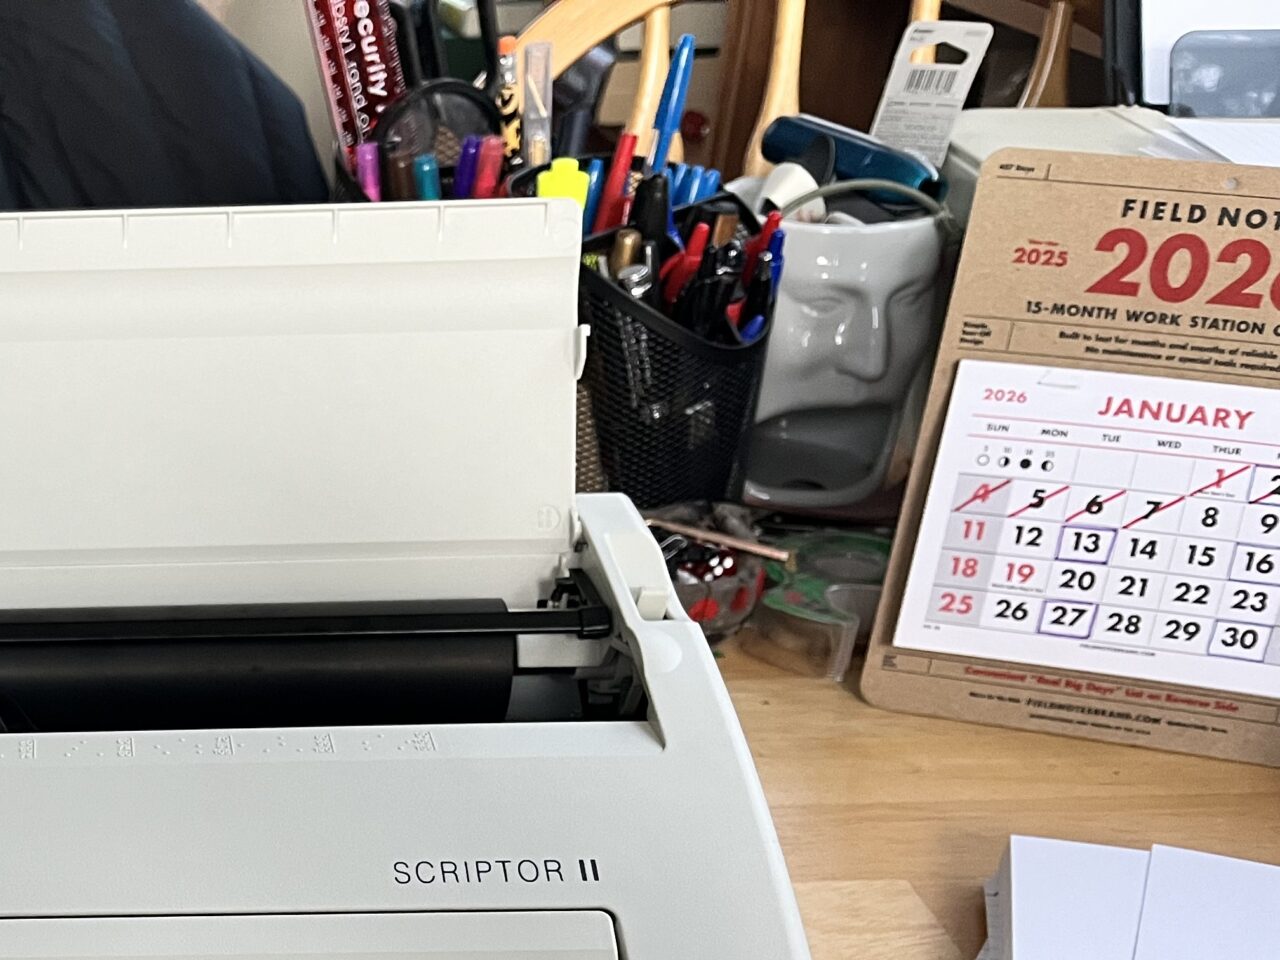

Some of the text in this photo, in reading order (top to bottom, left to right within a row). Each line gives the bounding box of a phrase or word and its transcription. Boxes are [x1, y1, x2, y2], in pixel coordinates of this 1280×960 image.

[1122, 199, 1206, 223] FIELD
[1013, 248, 1067, 267] 2025
[1085, 228, 1280, 312] 202
[1027, 301, 1117, 320] 15-MONTH
[1126, 310, 1182, 326] WORK
[1190, 316, 1265, 334] STATION
[984, 389, 1254, 429] 2026 JANUARY
[1214, 446, 1241, 454] THUR
[1029, 489, 1046, 508] 5
[1086, 495, 1103, 514] 6
[1201, 507, 1219, 527] 8
[1261, 514, 1279, 534] 9
[964, 521, 1273, 573] 11 12 13 14 15 16
[953, 557, 978, 577] 18
[1007, 563, 1034, 582] 19
[1060, 569, 1095, 590] 20
[1119, 576, 1148, 596] 21
[1174, 583, 1209, 604] 22
[1231, 590, 1267, 612] 23
[939, 593, 1258, 649] 25 26 27 28 29 30
[394, 860, 599, 884] SCRIPTOR II
